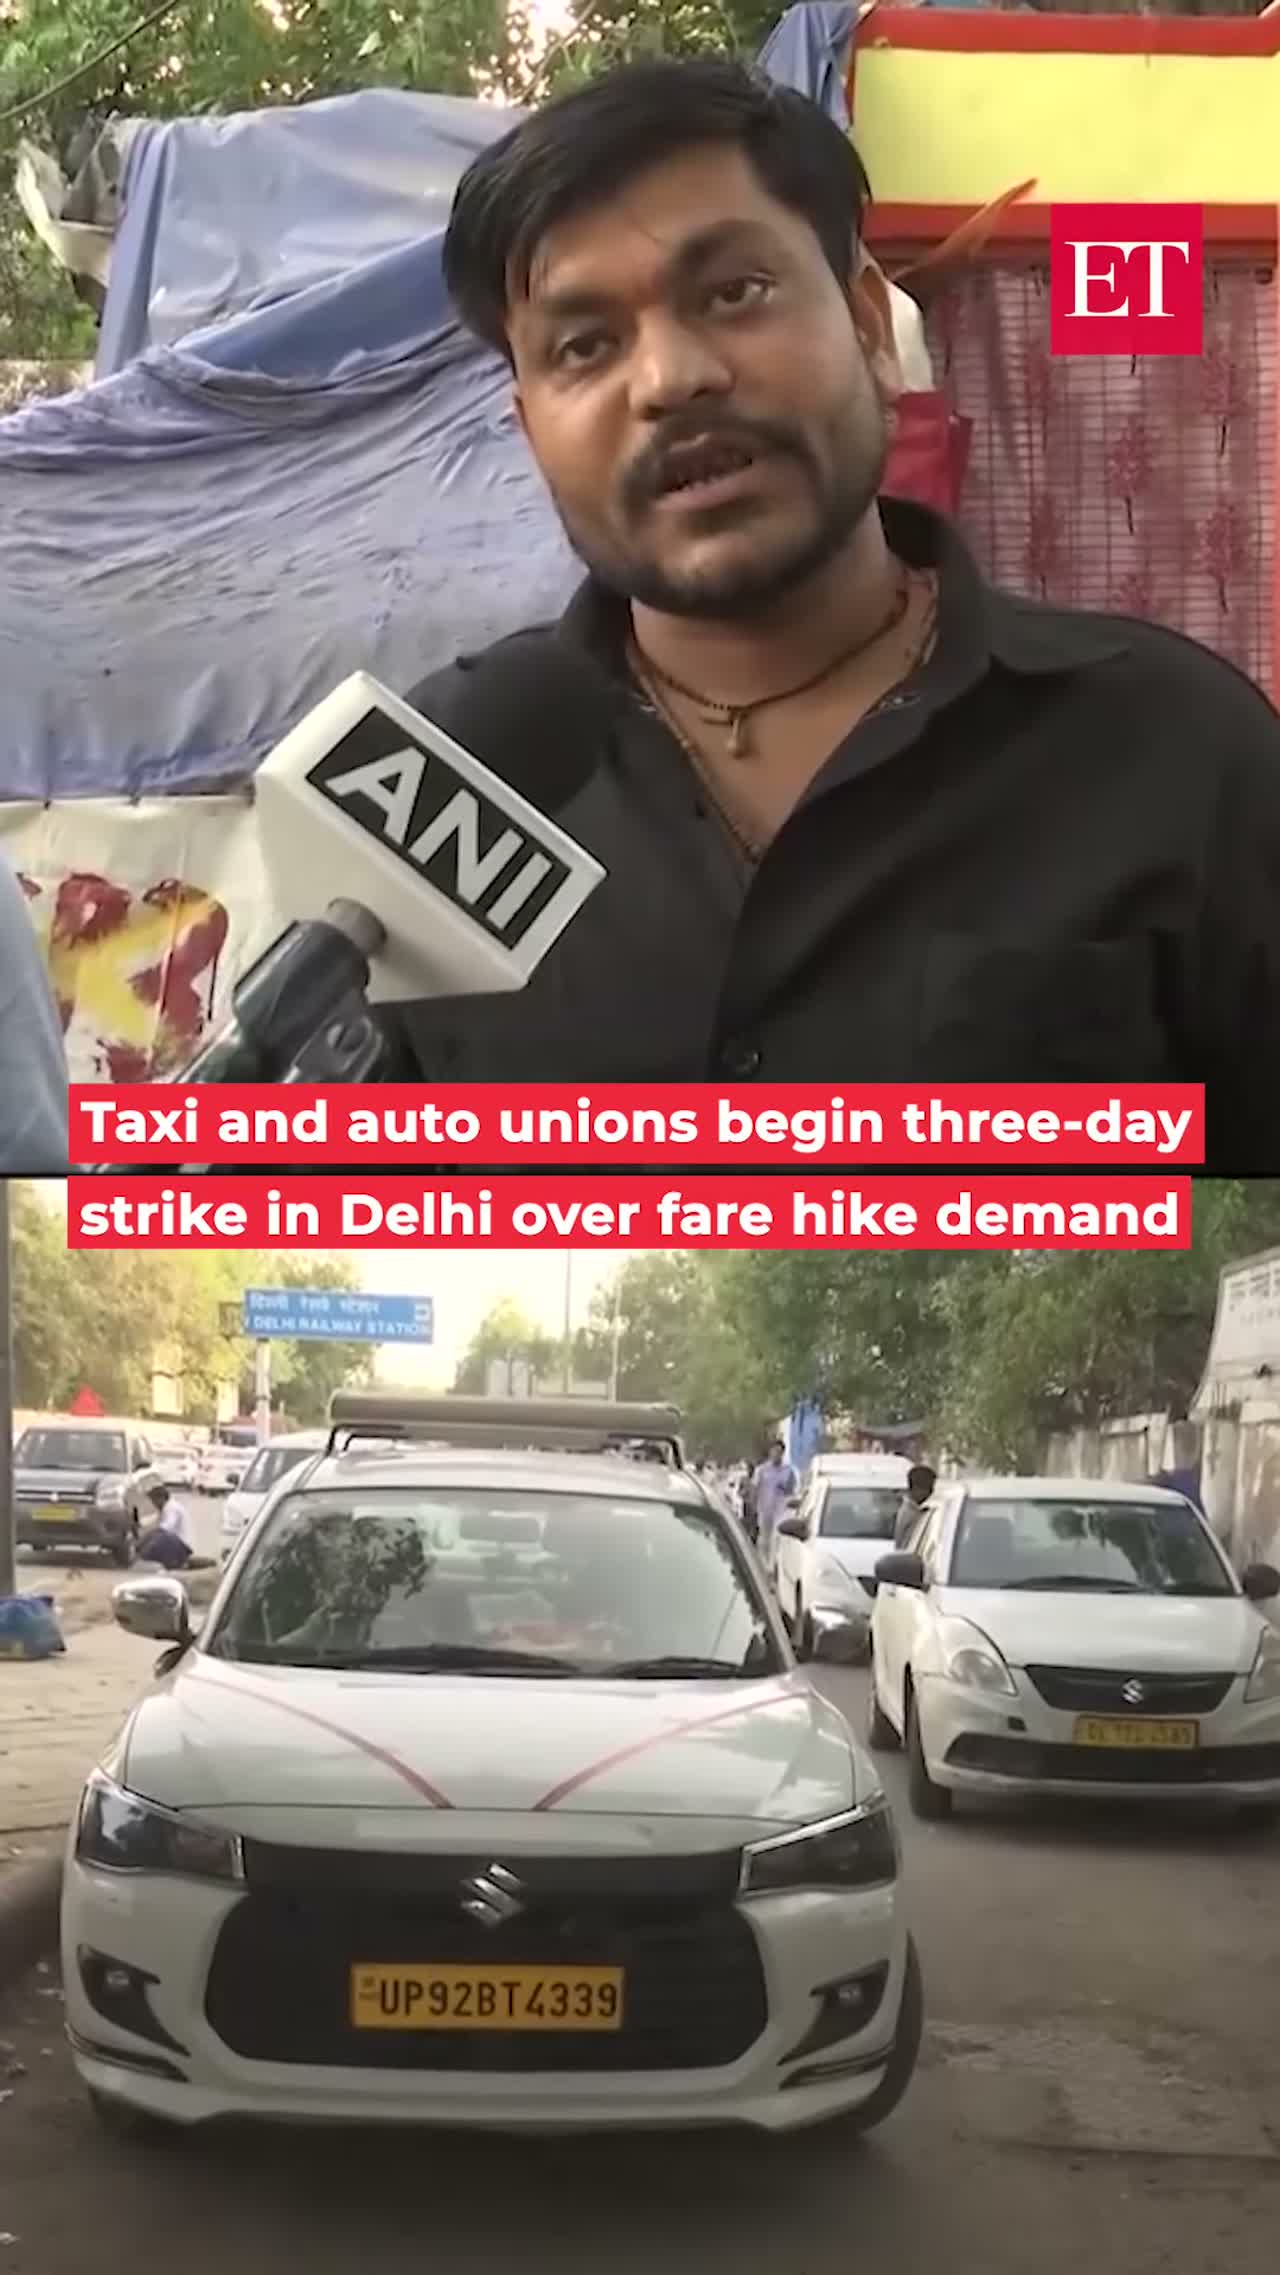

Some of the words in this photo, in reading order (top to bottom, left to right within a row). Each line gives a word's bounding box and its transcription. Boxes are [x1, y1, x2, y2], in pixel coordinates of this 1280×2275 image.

[324, 747, 552, 931] ANI
[253, 1315, 296, 1329] DELHI
[299, 1316, 361, 1333] RAILWAY
[380, 1979, 617, 2017] UP92BT4339
